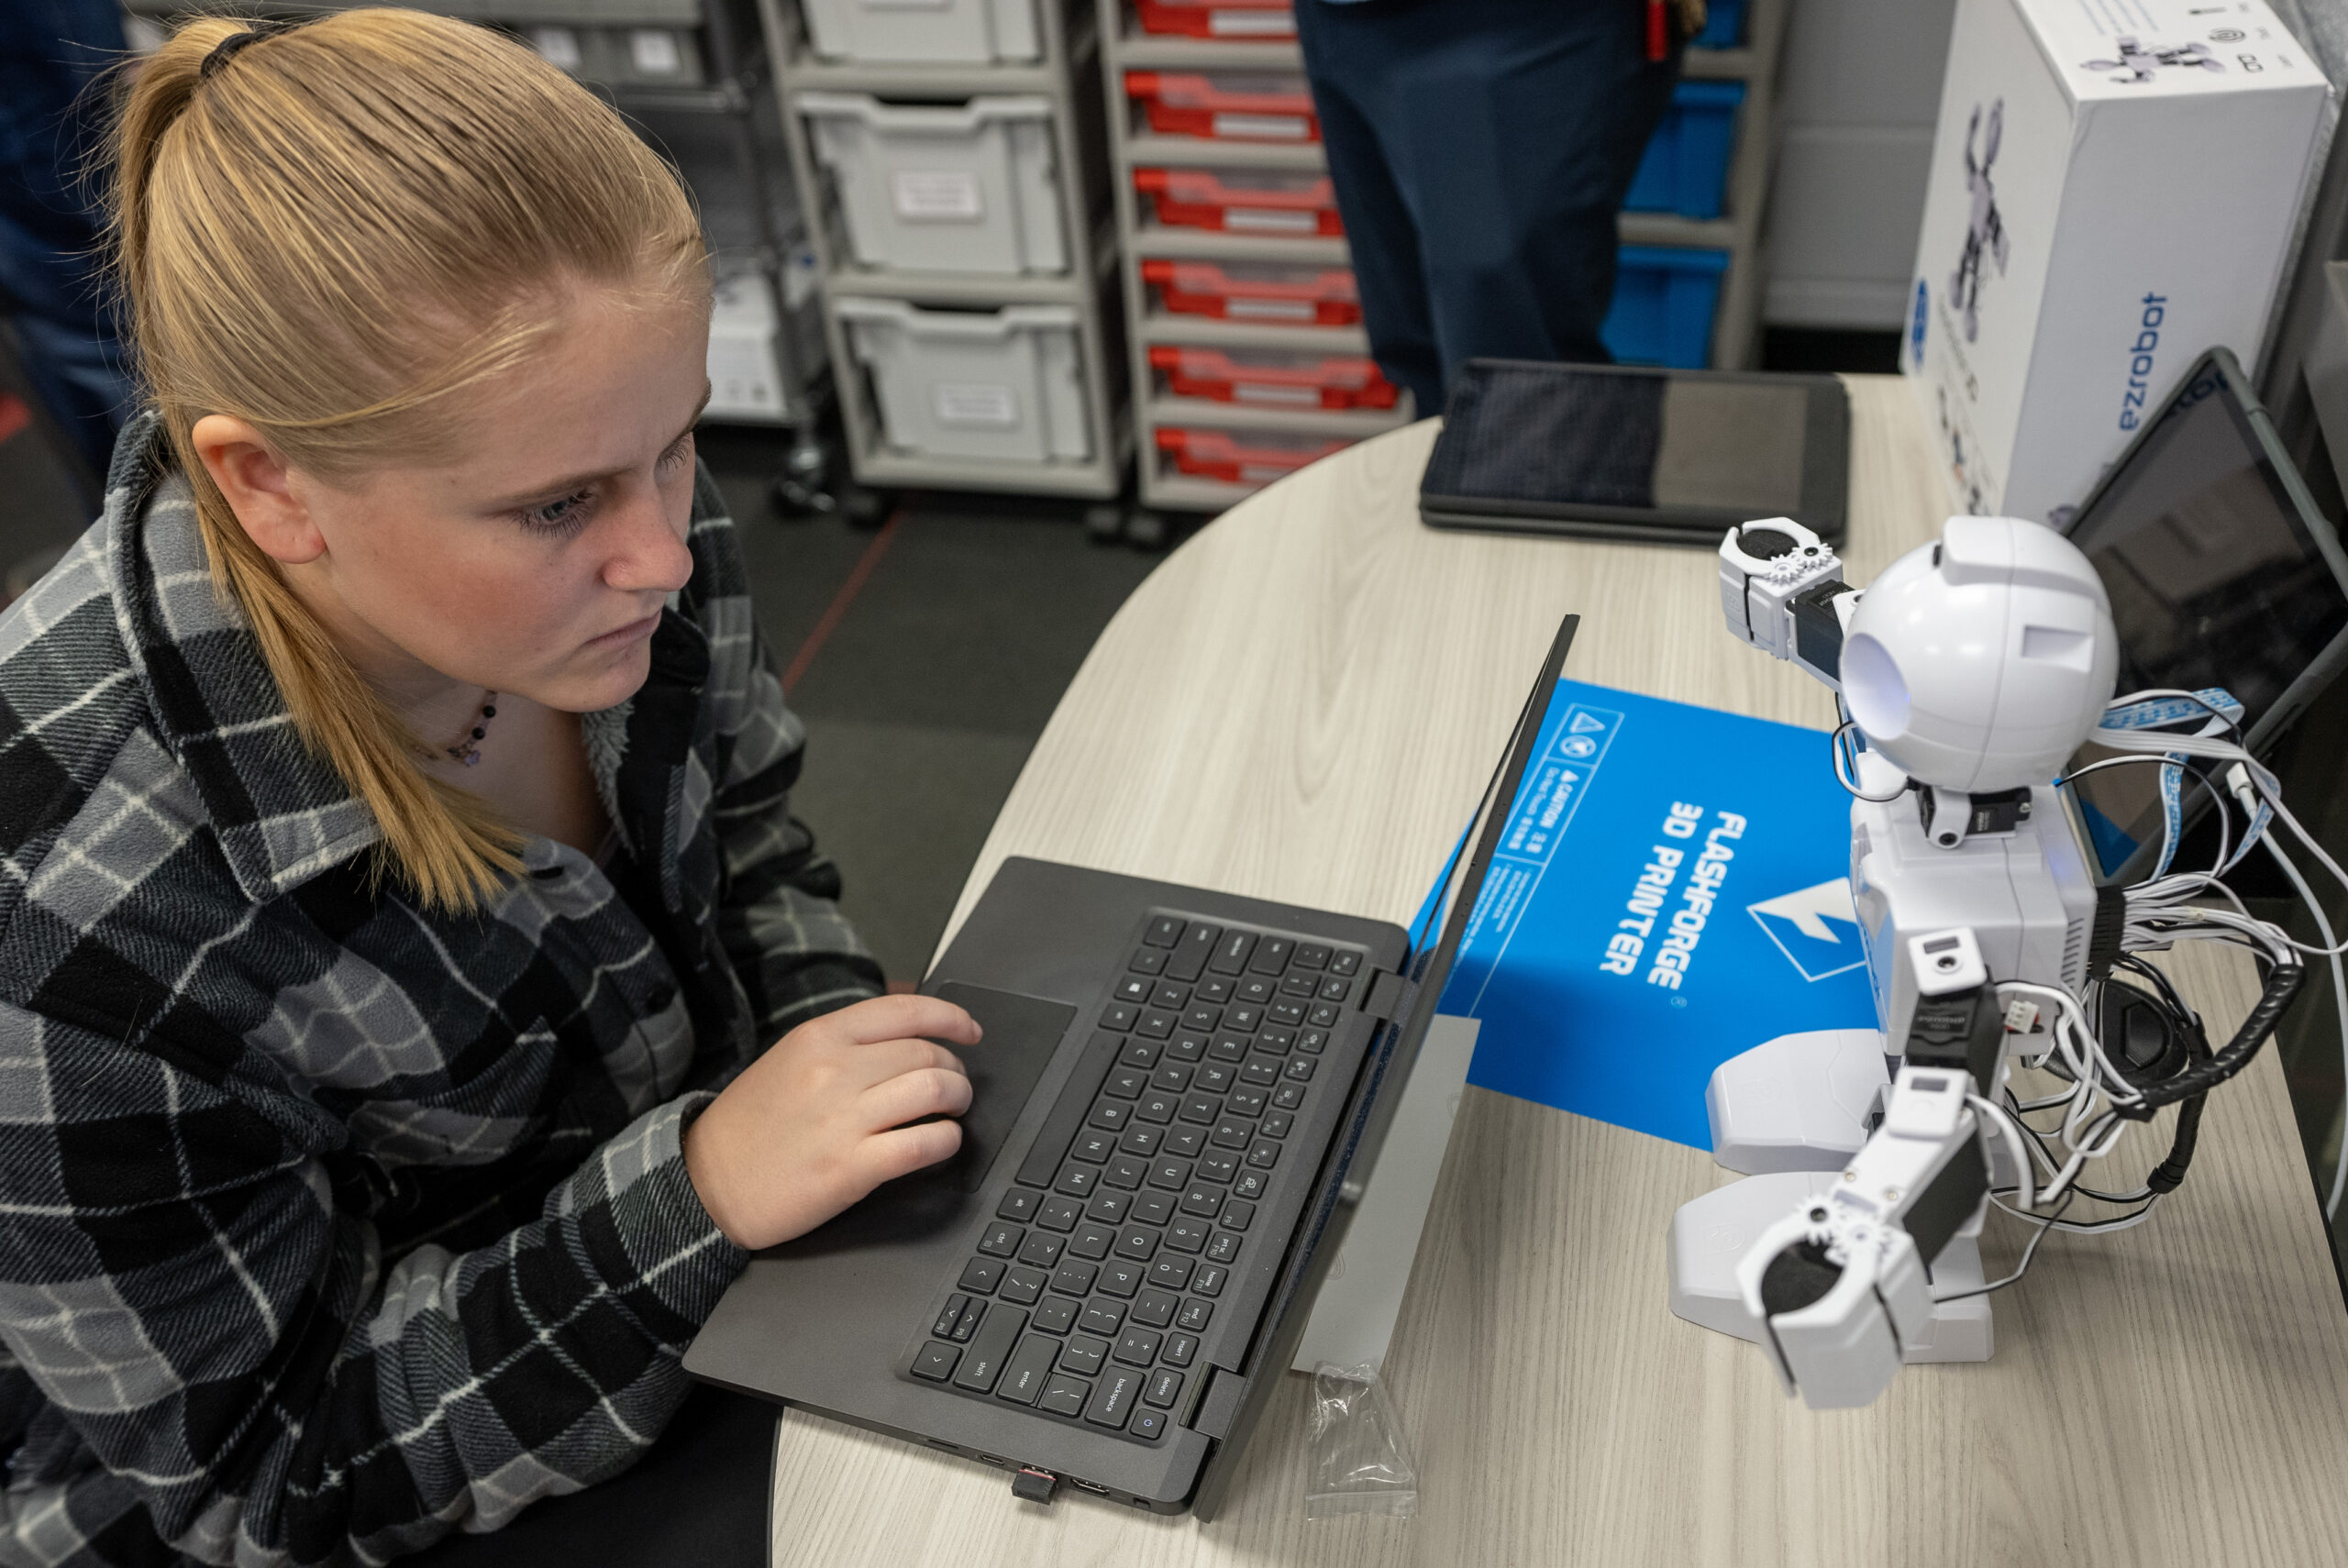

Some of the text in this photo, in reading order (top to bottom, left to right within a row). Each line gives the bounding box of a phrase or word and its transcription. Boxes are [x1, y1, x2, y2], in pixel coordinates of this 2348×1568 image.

[2120, 292, 2167, 433] ezrobot
[1599, 801, 1704, 976] 3D PRINTER
[1646, 810, 1747, 991] FLASHFORGE
[1211, 983, 1221, 991] A
[1166, 990, 1178, 999] Z
[1277, 1004, 1288, 1012] 2
[1237, 1011, 1249, 1021] W
[1181, 1041, 1194, 1049] D
[1224, 1041, 1235, 1049] E
[1135, 1048, 1148, 1056] C
[1168, 1071, 1180, 1079] F
[1151, 1101, 1164, 1110] G
[1105, 1110, 1117, 1118] B
[1136, 1134, 1148, 1143] H
[1089, 1141, 1102, 1150] N
[1121, 1167, 1131, 1176] J
[1165, 1168, 1177, 1176] U
[1071, 1173, 1085, 1184] M
[1103, 1200, 1116, 1209] K
[1225, 1215, 1232, 1224] F9
[997, 1232, 1005, 1243] ctrl
[1132, 1237, 1145, 1245] O
[1159, 1264, 1170, 1272] 0
[1116, 1273, 1128, 1281] P
[1205, 1271, 1217, 1286] home
[1196, 1279, 1204, 1290] F11
[1180, 1312, 1190, 1323] F12
[1191, 1308, 1200, 1320] end
[936, 1321, 946, 1331] pg
[956, 1327, 965, 1337] pg
[1175, 1341, 1187, 1356] insert
[974, 1362, 986, 1376] shift
[1019, 1372, 1029, 1388] enter
[1158, 1377, 1170, 1395] delete
[1106, 1378, 1126, 1411] backspace
